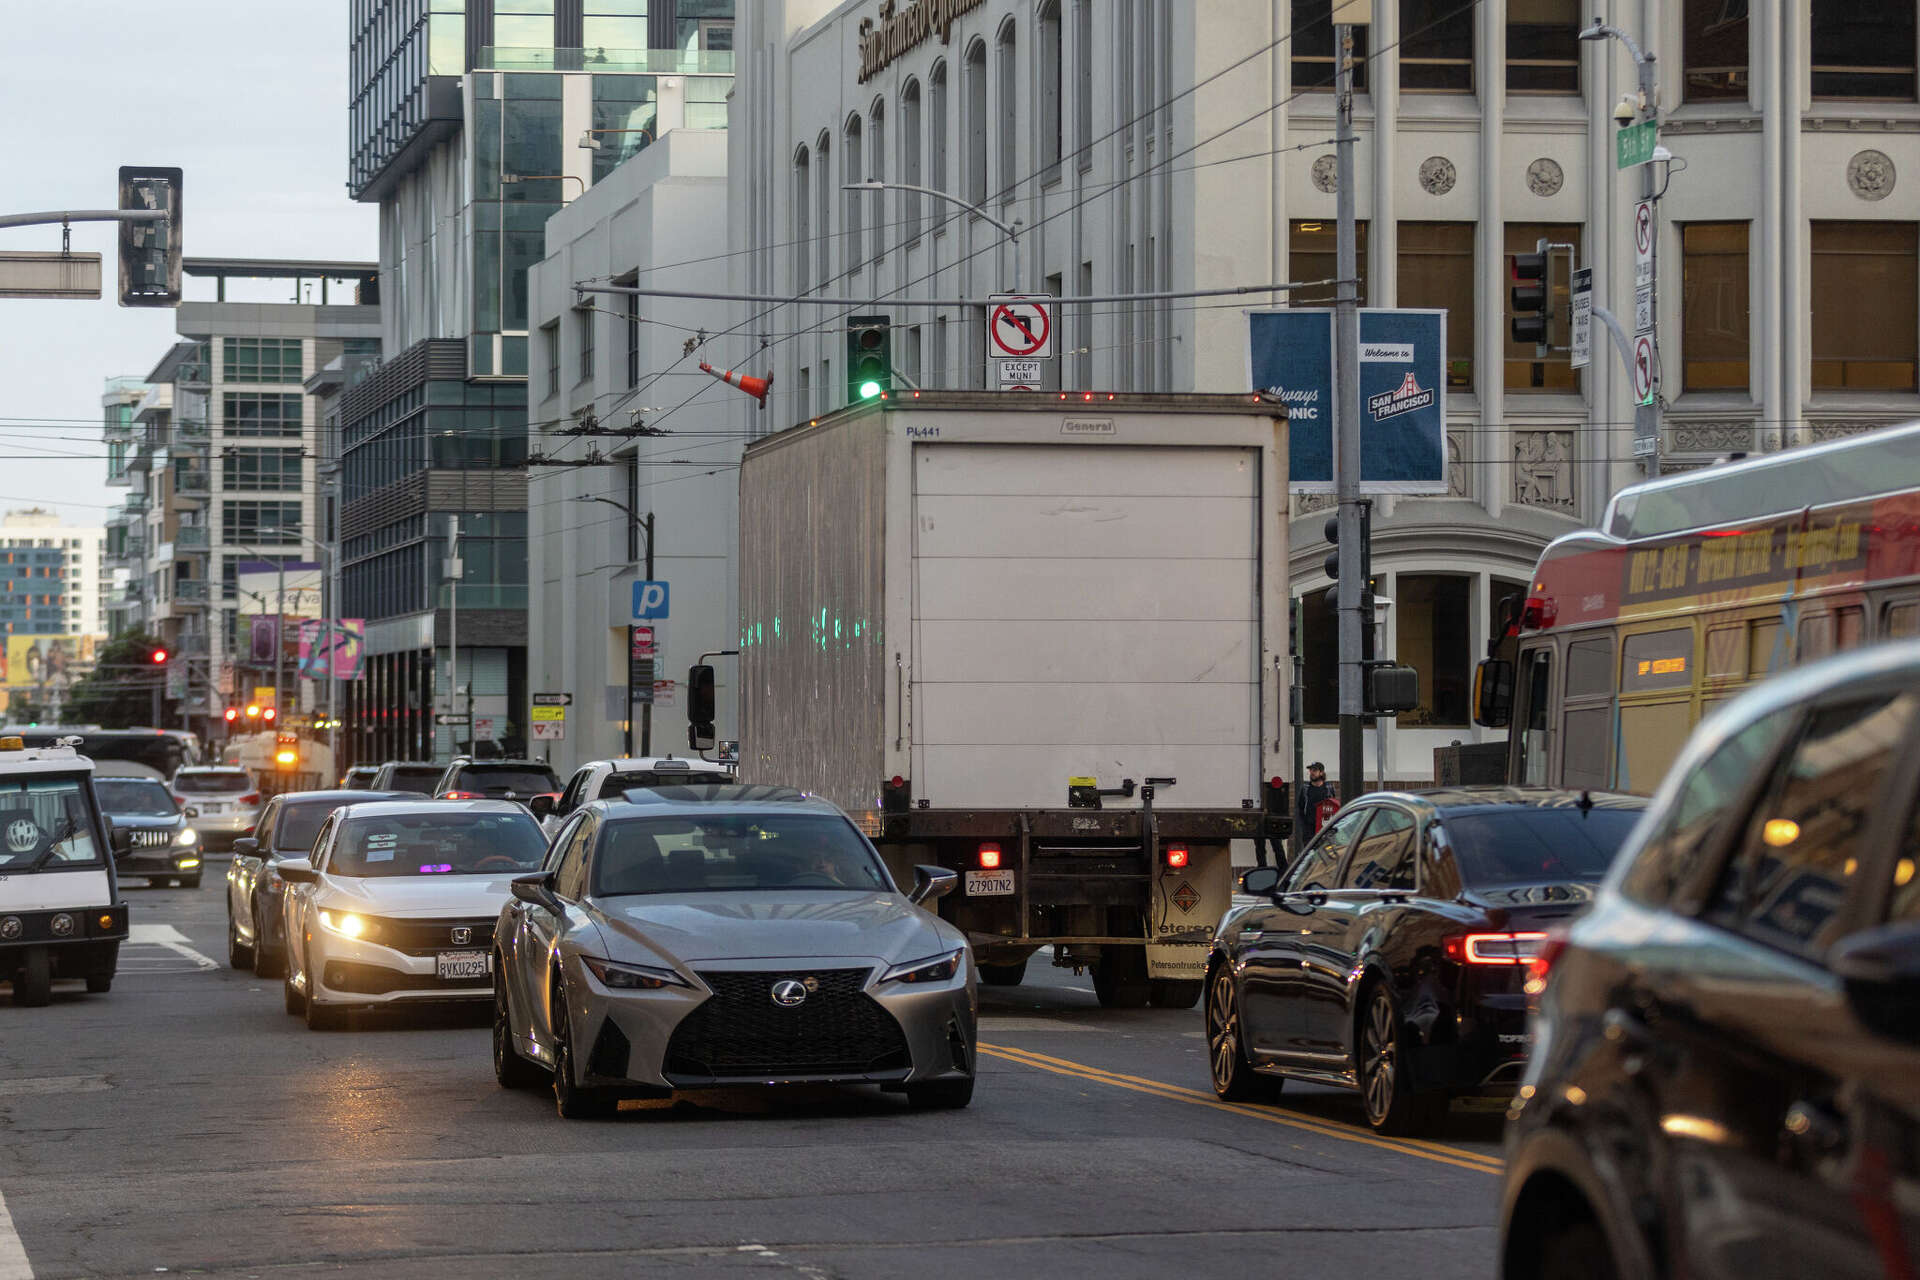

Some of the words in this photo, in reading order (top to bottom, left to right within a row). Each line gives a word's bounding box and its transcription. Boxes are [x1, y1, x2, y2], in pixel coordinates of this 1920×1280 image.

[1365, 348, 1399, 358] Welcome
[1005, 363, 1038, 371] EXCEPT
[1009, 372, 1032, 380] MUNI
[1372, 394, 1392, 409] SAN
[1378, 393, 1430, 416] FRANCISCO
[906, 426, 940, 437] PL441
[1065, 422, 1112, 431] General
[969, 879, 1012, 893] 27907N2
[440, 961, 485, 977] 8VKU295
